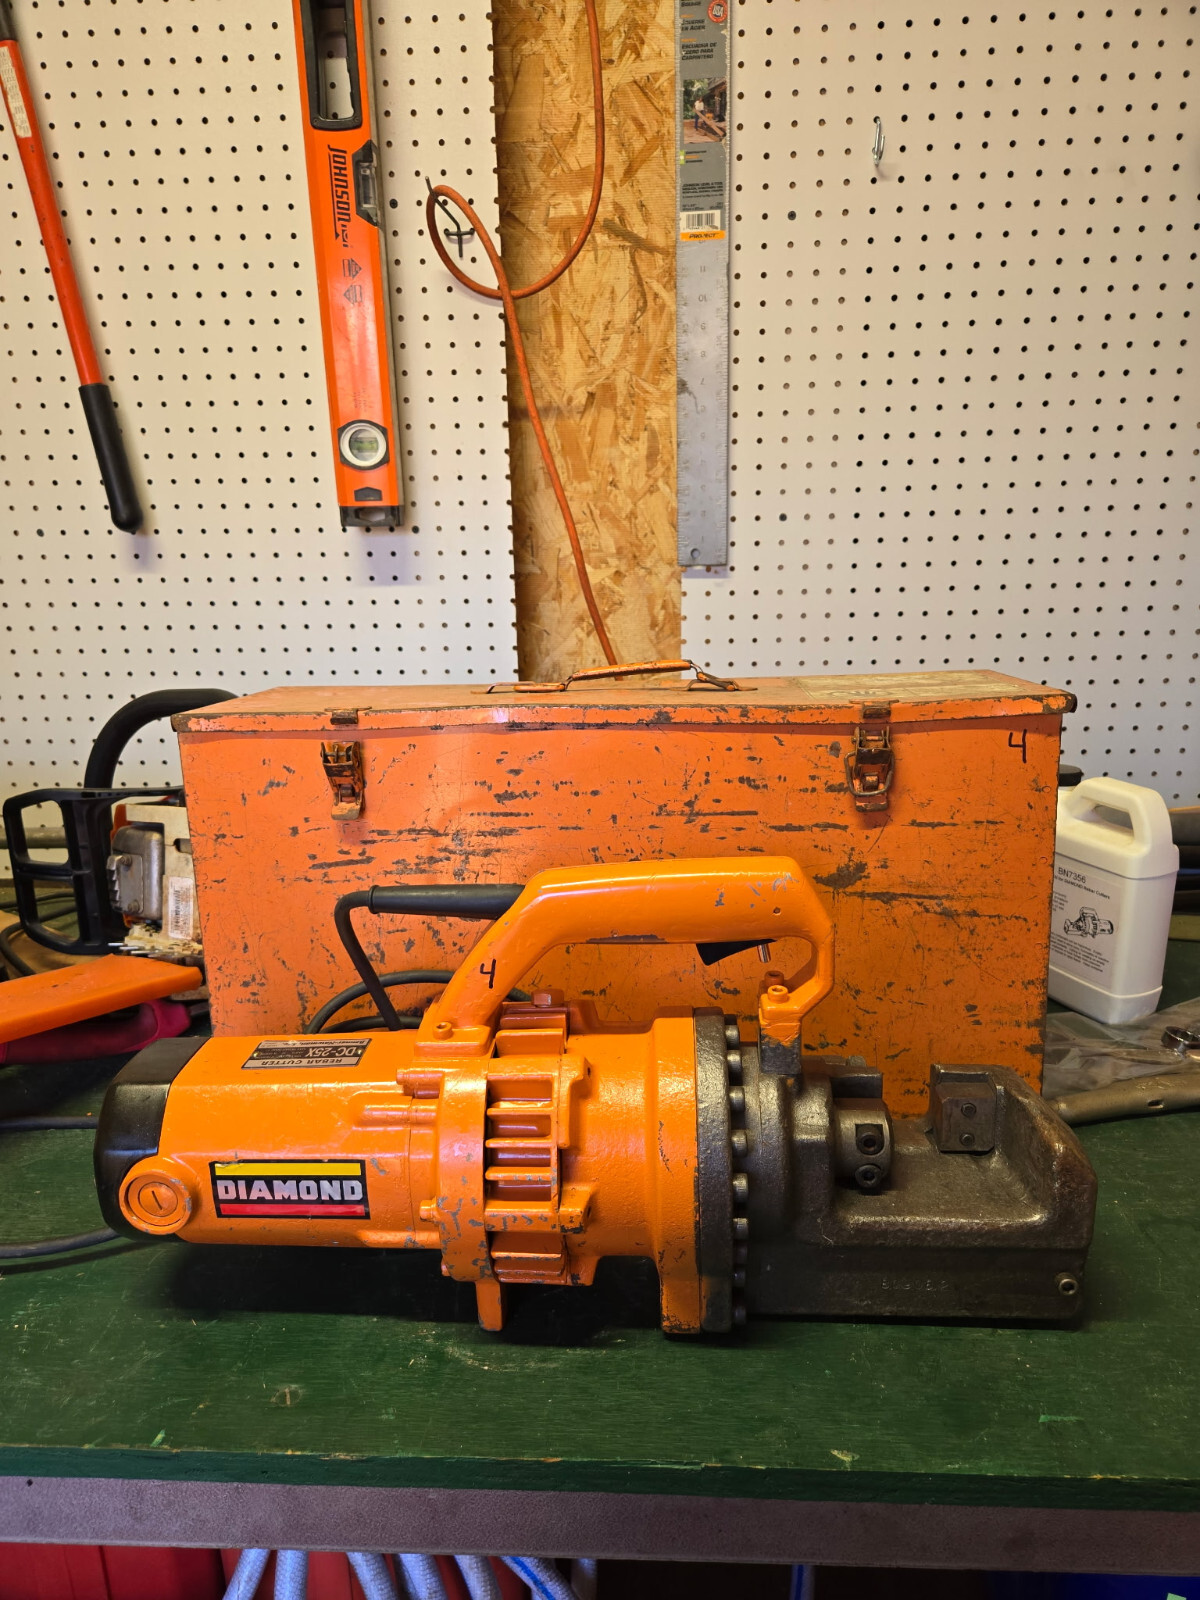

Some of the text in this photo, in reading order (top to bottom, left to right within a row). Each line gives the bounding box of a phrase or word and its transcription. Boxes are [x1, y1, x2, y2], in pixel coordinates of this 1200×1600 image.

[328, 144, 351, 223] JOHNSON
[1008, 728, 1027, 764] 4
[1058, 866, 1087, 884] BN7356
[479, 958, 497, 989] 4
[261, 1057, 343, 1066] REBAR CUTTER
[305, 1046, 357, 1057] DC-25X
[216, 1179, 364, 1201] DIAMOND
